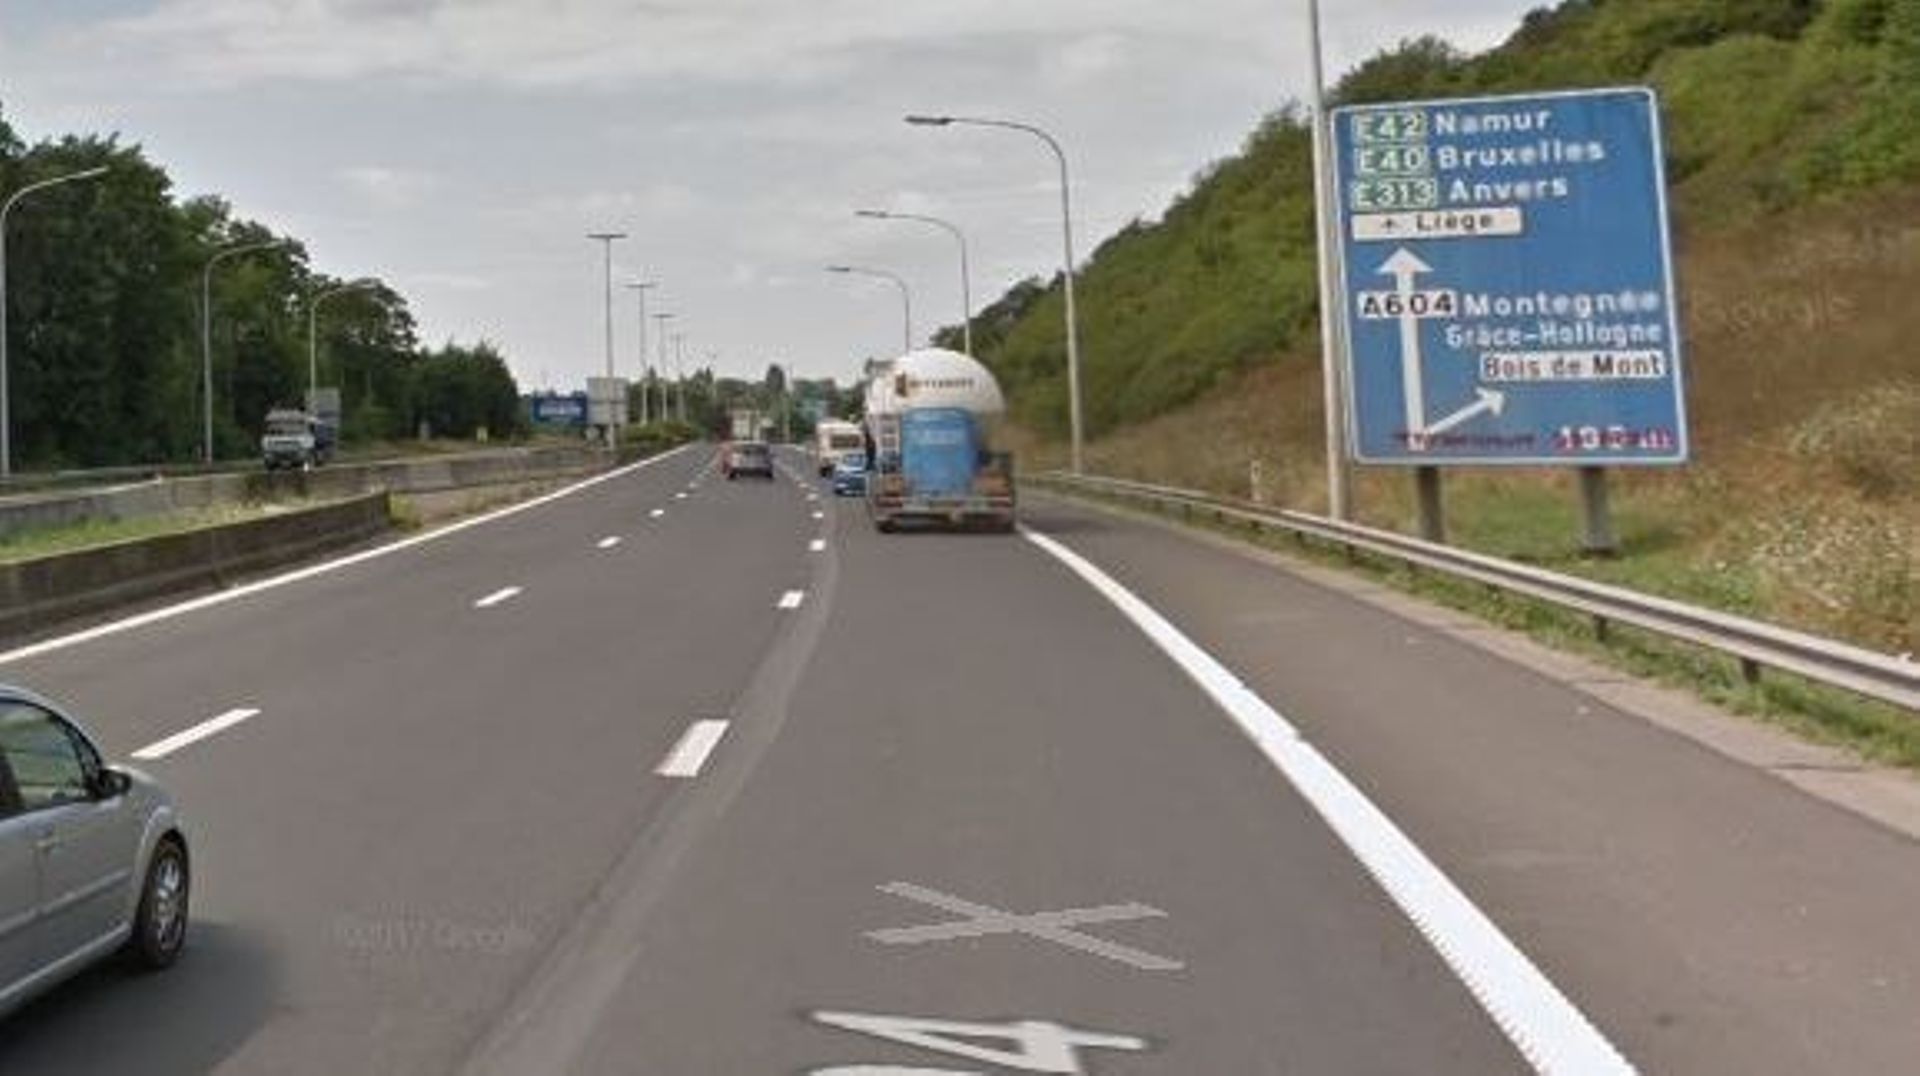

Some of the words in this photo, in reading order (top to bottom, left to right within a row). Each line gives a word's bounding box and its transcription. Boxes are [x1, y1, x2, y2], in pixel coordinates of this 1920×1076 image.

[1355, 113, 1424, 139] E42
[1435, 110, 1551, 136] Namur
[1358, 146, 1425, 173] E40
[1439, 140, 1605, 170] Bruxelles
[1355, 178, 1434, 206] E313
[1449, 177, 1568, 202] Anvers
[1363, 292, 1453, 317] A604
[1484, 355, 1540, 378] Bois
[1552, 355, 1581, 376] de
[1592, 353, 1660, 376] Mont
